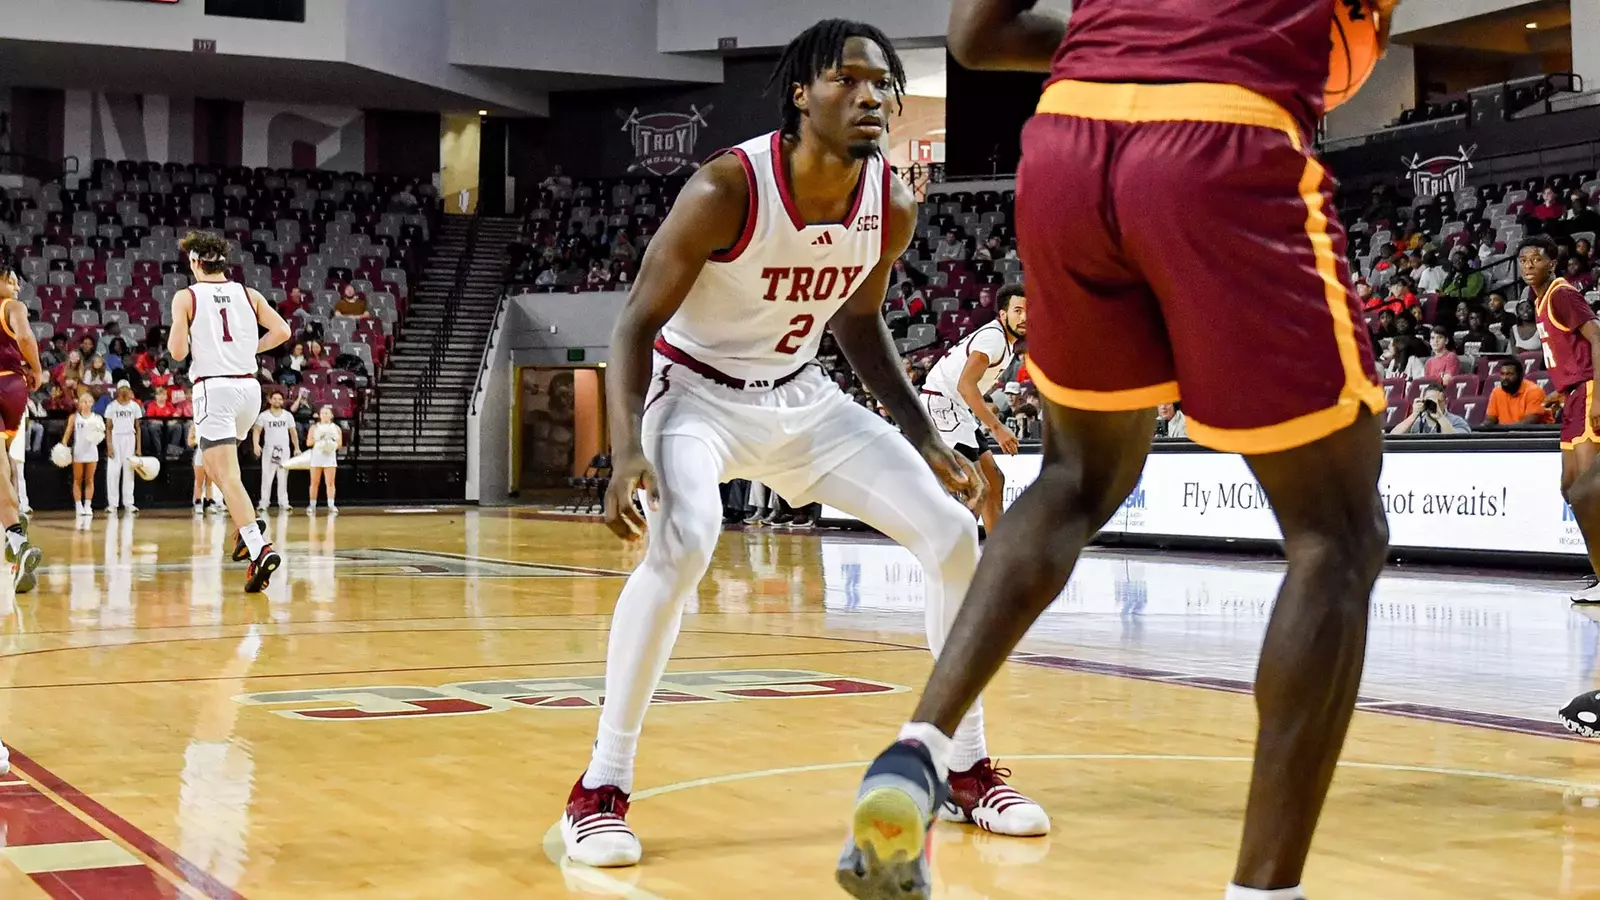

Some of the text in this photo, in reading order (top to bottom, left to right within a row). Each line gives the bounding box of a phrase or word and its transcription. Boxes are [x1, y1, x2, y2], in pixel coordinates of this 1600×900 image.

[641, 128, 687, 155] TROY
[761, 264, 864, 303] TROY
[219, 308, 233, 342] 1
[775, 313, 815, 355] 2
[115, 411, 133, 419] TROY
[268, 420, 286, 428] TROY
[1183, 482, 1210, 514] Fly
[1423, 486, 1507, 517] awaits!
